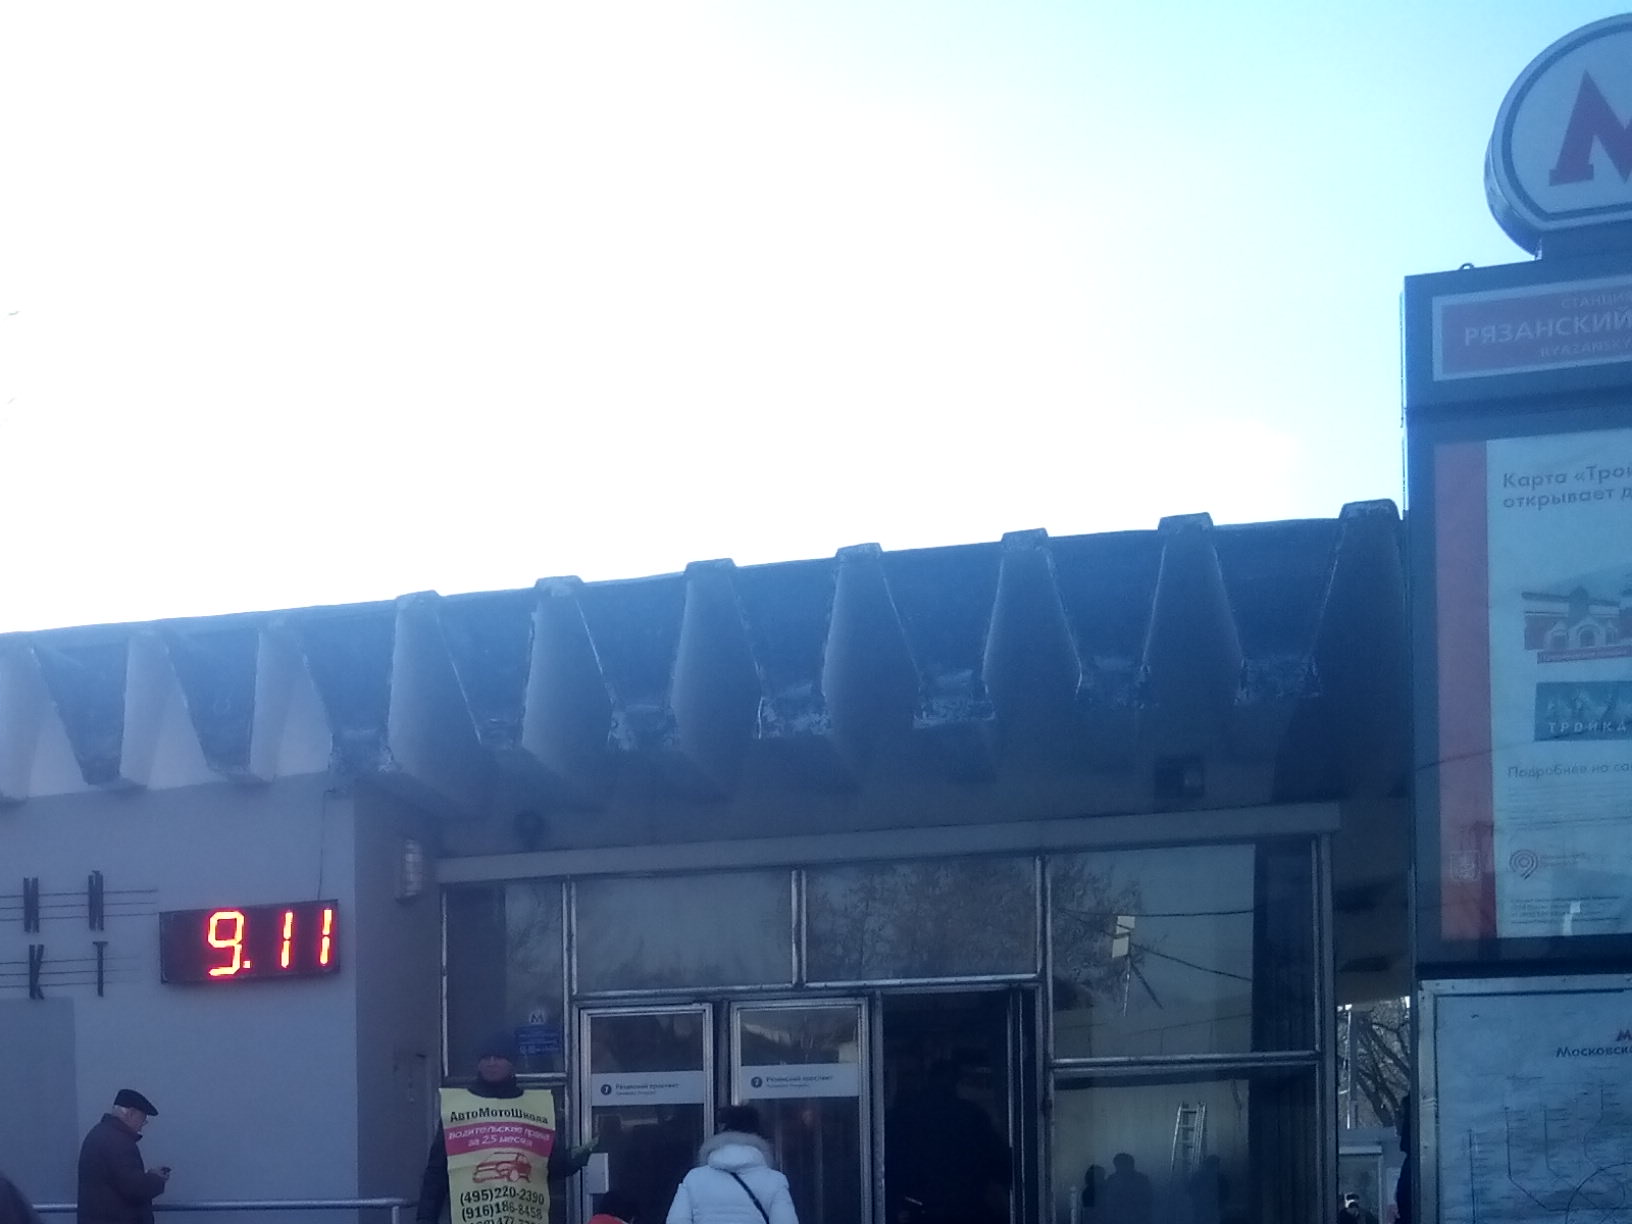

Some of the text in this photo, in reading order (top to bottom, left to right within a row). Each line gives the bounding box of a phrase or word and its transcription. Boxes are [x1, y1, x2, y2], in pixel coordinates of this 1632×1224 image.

[1560, 293, 1632, 309] СТАНЦИ
[1464, 306, 1632, 346] РЯЗАНСКИЙ
[1503, 472, 1567, 491] Карта
[1503, 488, 1616, 511] открывает
[450, 1107, 548, 1124] АвтоМотоШкола
